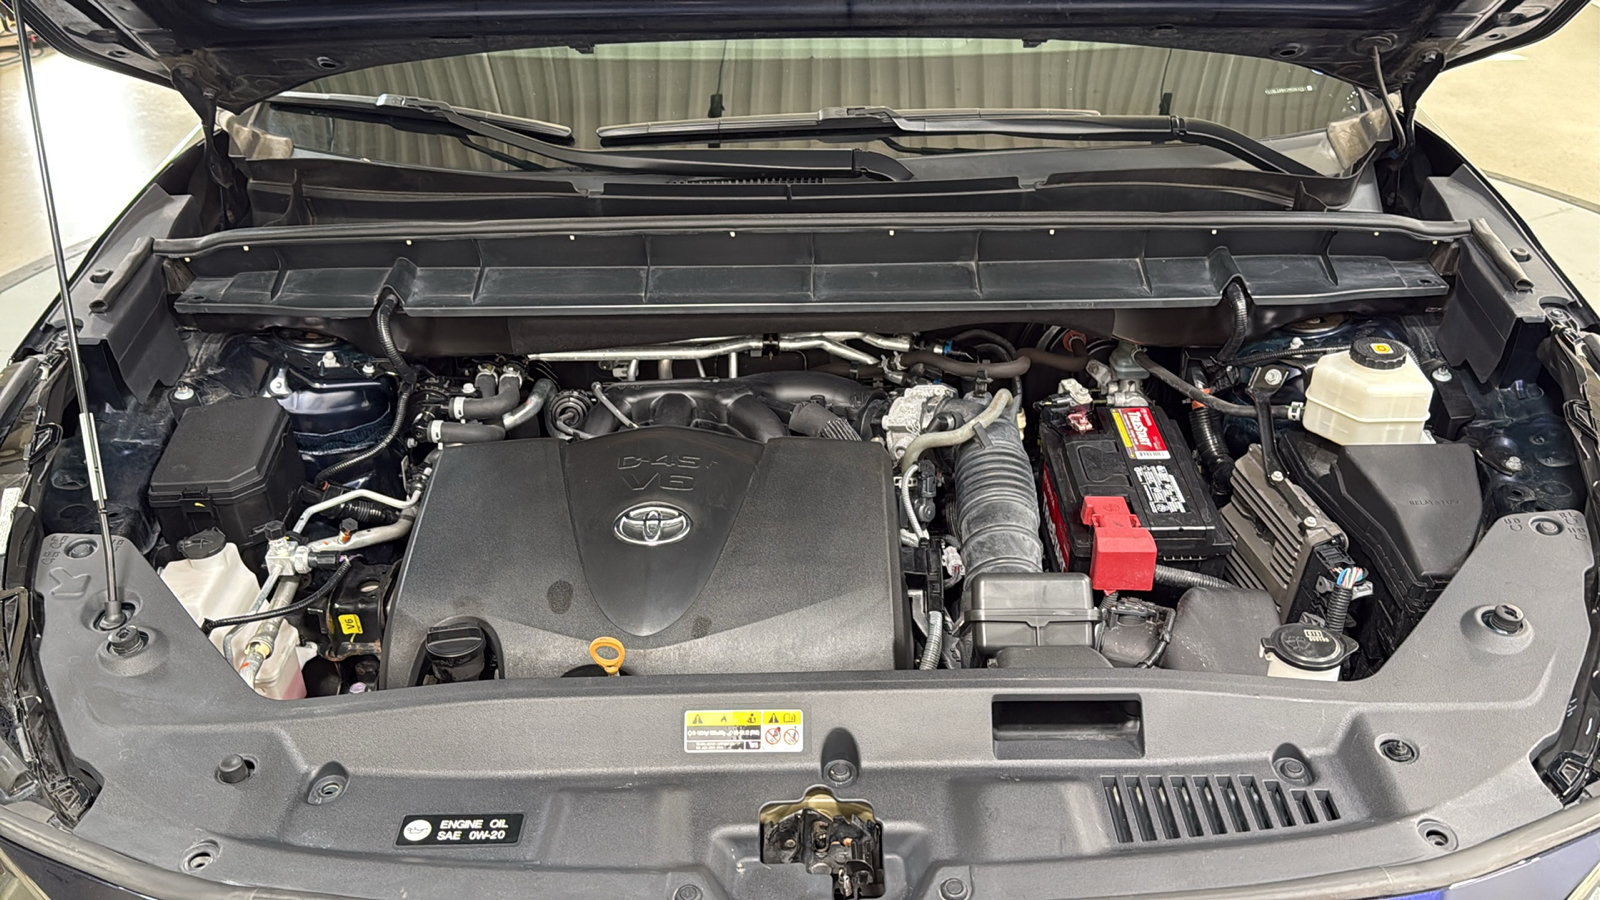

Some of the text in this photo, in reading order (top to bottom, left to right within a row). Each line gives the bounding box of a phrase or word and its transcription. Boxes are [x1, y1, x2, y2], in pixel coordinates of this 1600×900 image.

[621, 472, 694, 491] V6
[344, 618, 355, 630] V6
[440, 819, 509, 830] ENGINE OIL
[436, 830, 506, 841] SAE 0W-20
